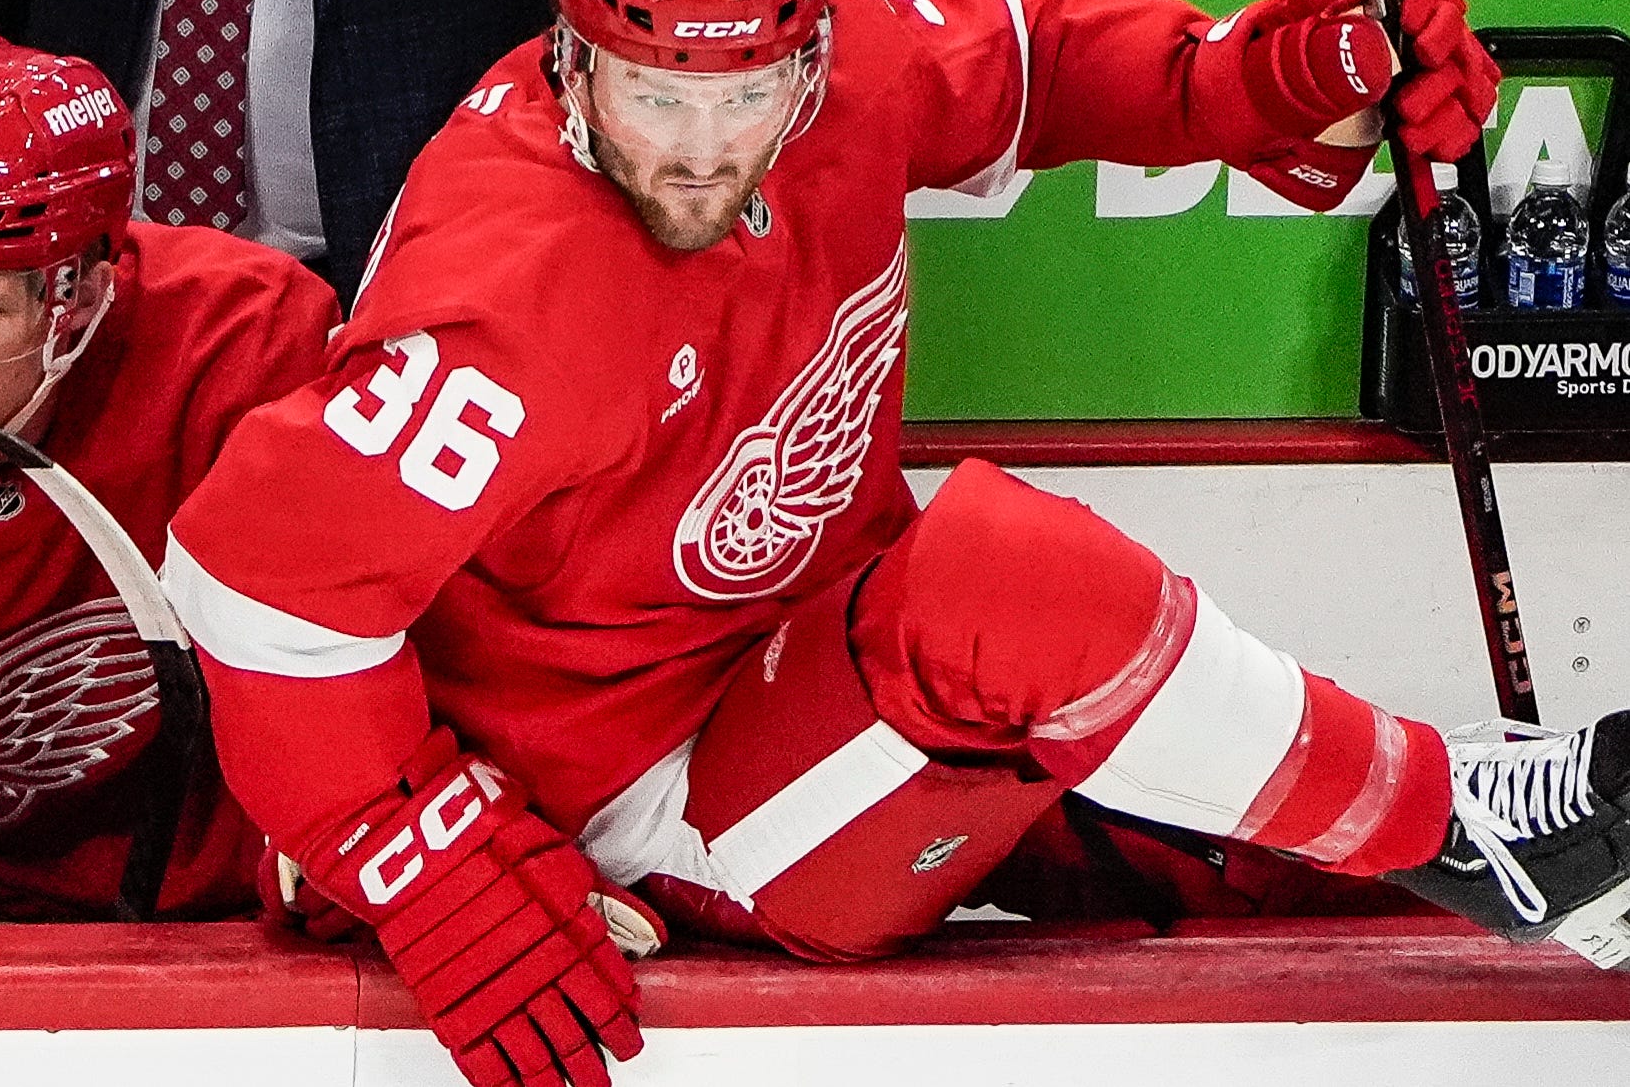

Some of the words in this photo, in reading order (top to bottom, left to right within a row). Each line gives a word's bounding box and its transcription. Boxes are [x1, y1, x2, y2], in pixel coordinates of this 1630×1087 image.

[673, 17, 763, 38] CCM
[1339, 22, 1369, 94] CCM
[43, 83, 118, 137] meijer
[1466, 342, 1630, 380] ODYARM
[660, 367, 706, 425] PRIOR
[1557, 380, 1616, 398] Sports
[322, 328, 528, 513] 36
